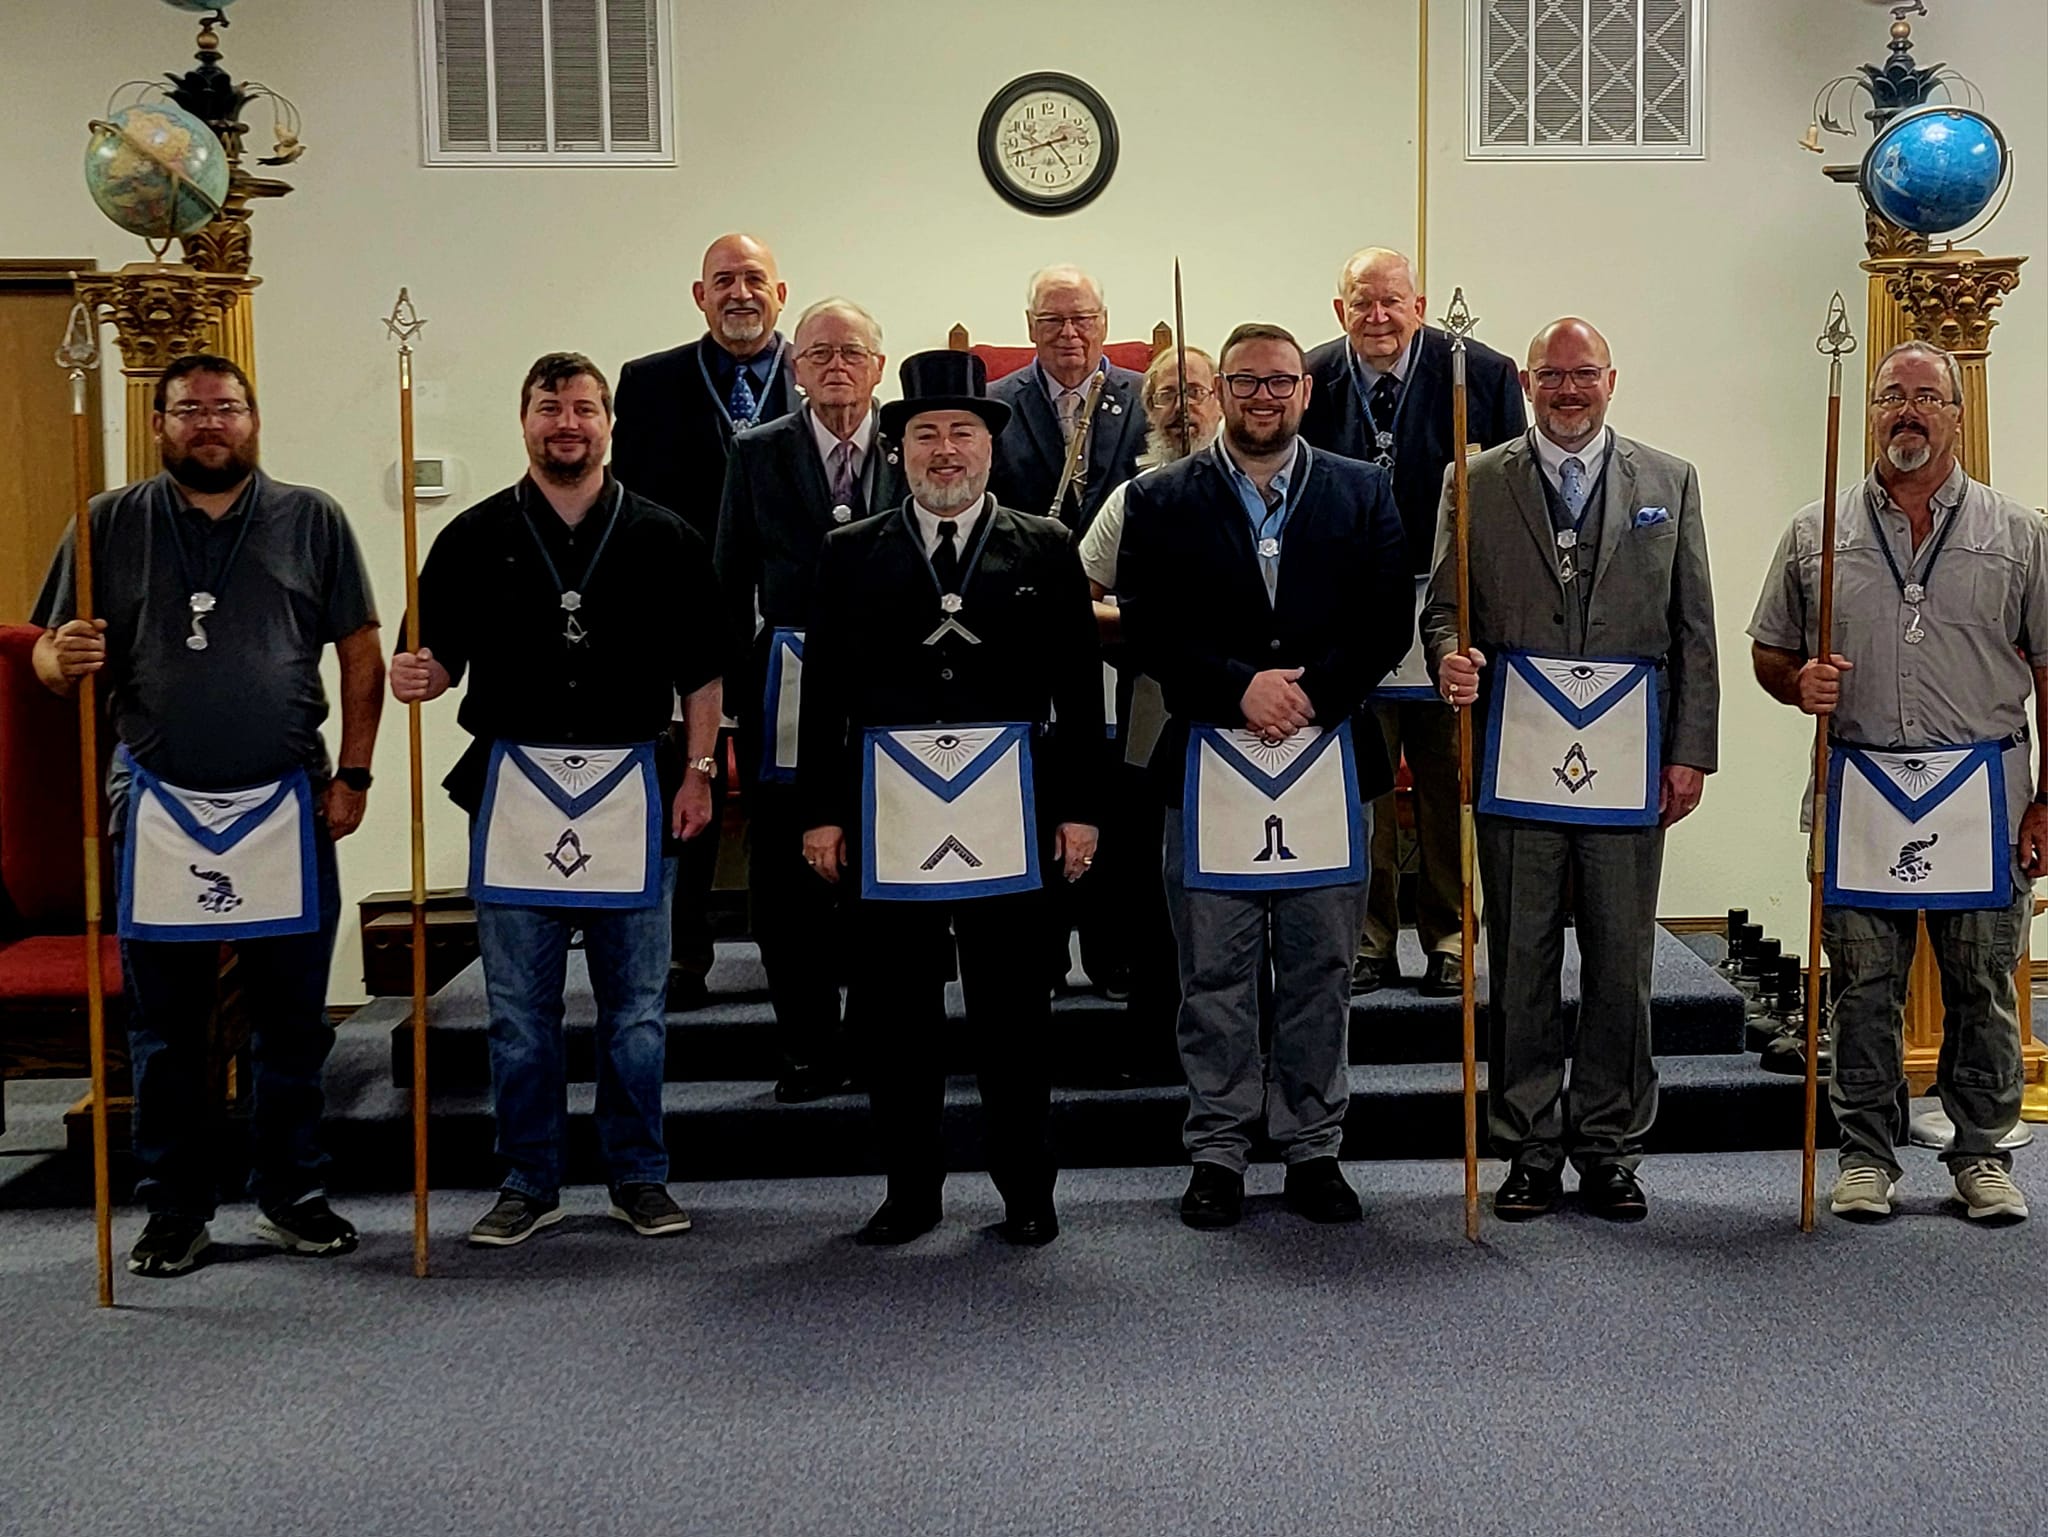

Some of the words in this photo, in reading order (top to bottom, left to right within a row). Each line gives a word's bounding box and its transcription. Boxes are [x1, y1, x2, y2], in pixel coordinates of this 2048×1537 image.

[1027, 107, 1034, 119] 11
[1042, 103, 1054, 115] 12
[1074, 118, 1084, 130] 2
[1008, 138, 1018, 149] 9
[1029, 167, 1038, 179] 7
[1044, 171, 1055, 183] 6
